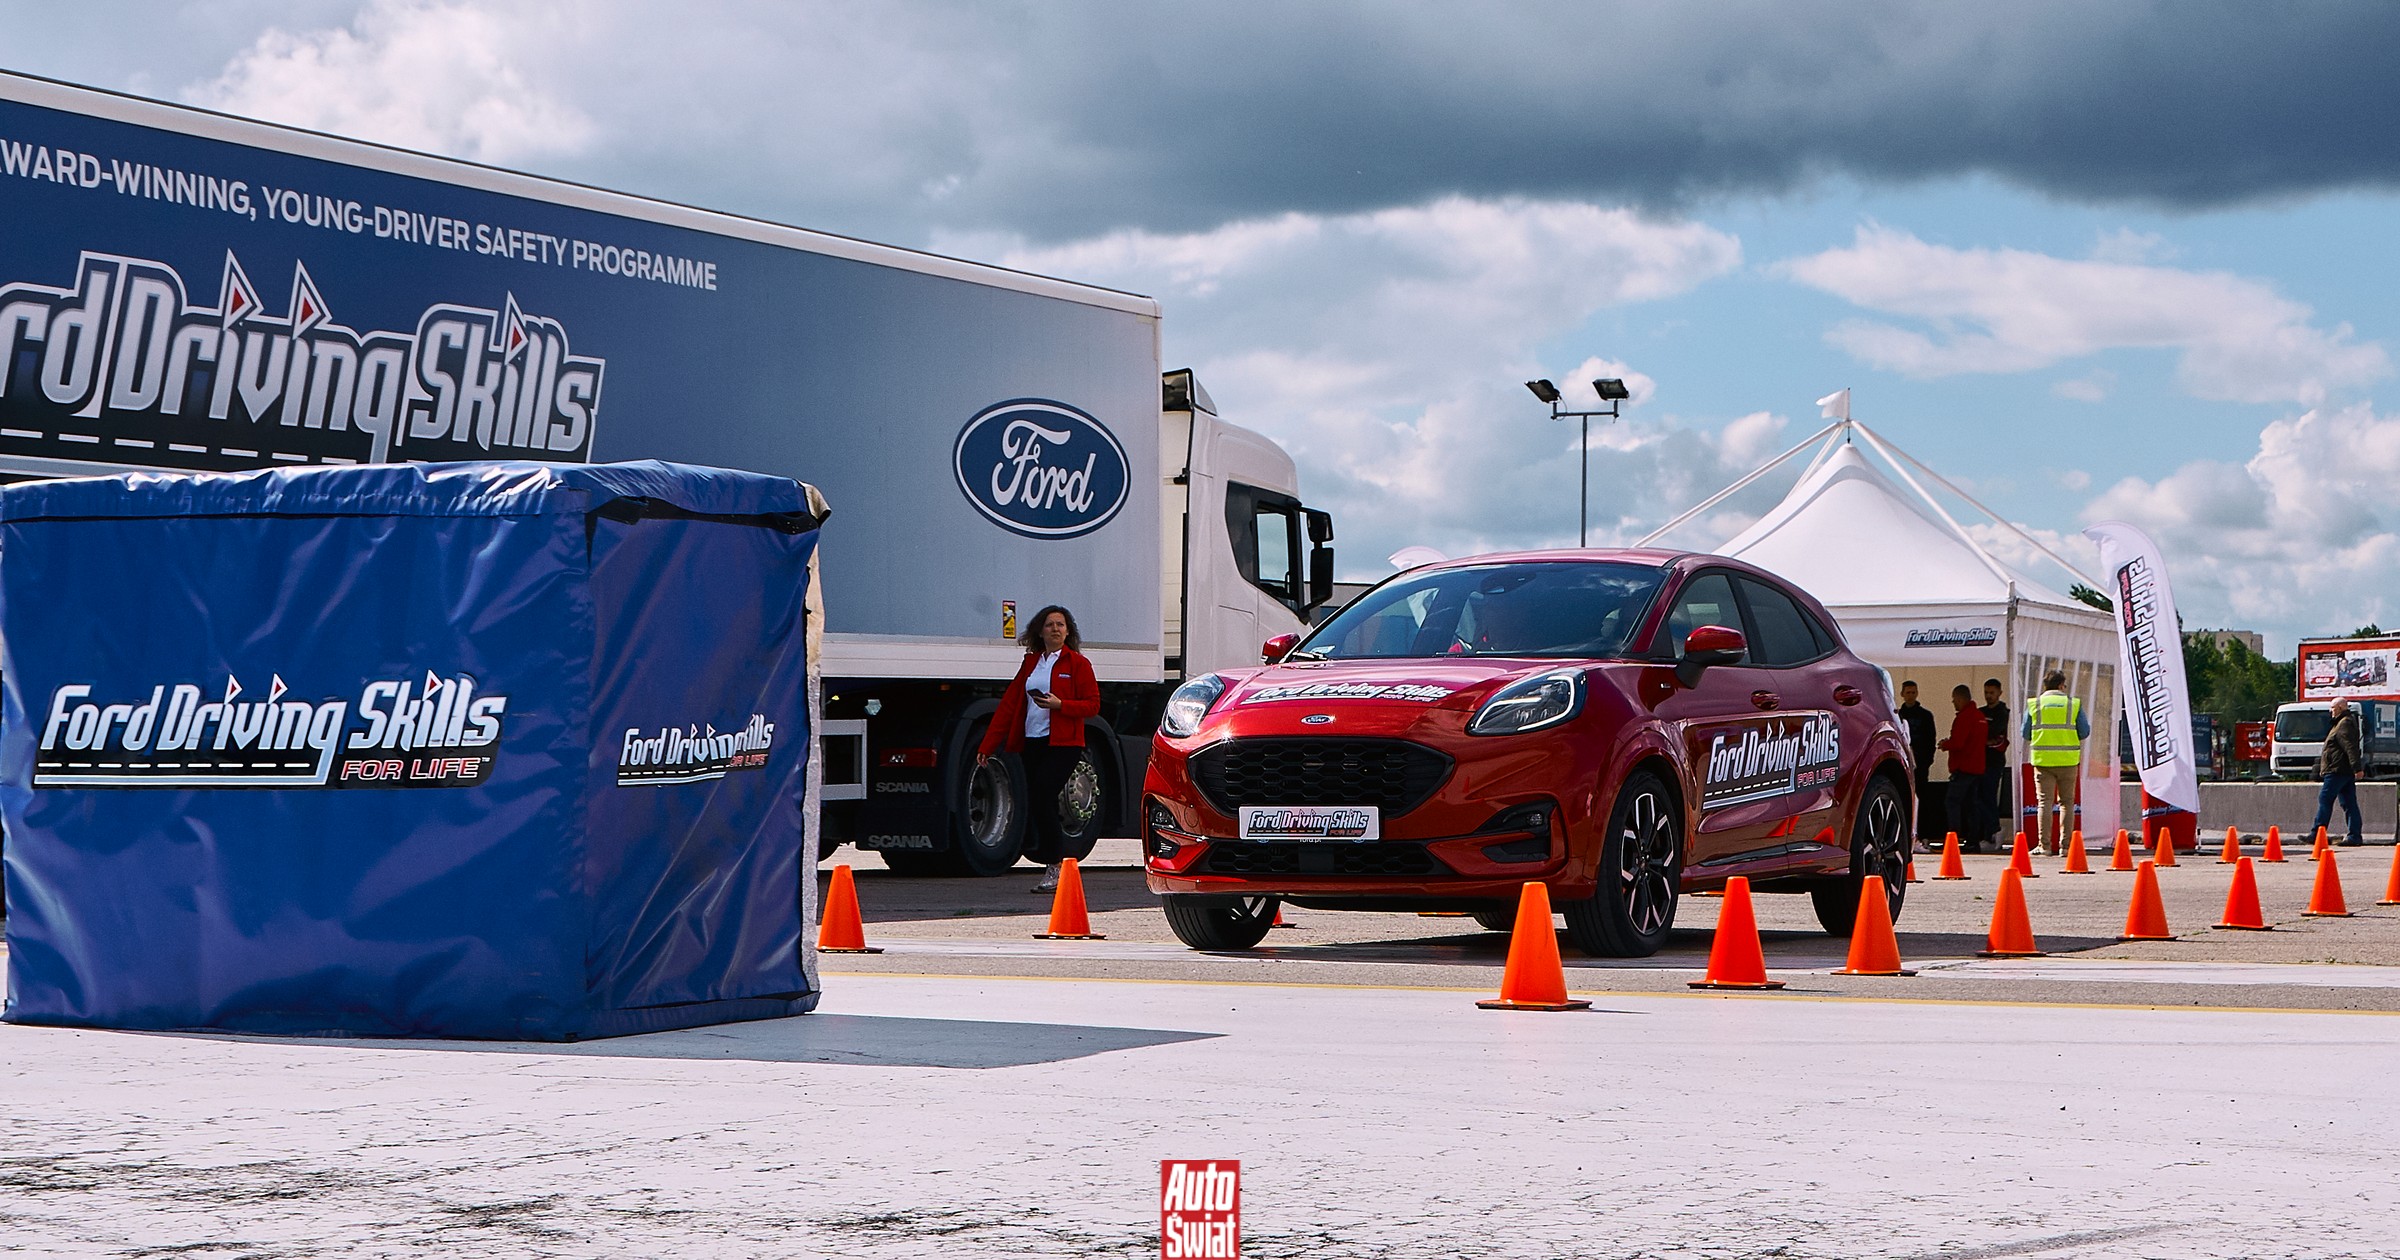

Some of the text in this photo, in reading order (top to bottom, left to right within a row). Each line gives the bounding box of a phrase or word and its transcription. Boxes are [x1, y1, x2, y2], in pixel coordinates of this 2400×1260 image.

[0, 139, 717, 291] WARD-WINNING, YOUNG-DRIVER SAFETY PROGRAMME
[108, 270, 404, 464] Driving
[409, 312, 595, 451] Skills
[992, 419, 1097, 513] Ford
[1907, 627, 1997, 645] Ford Driving Skills
[39, 669, 507, 785] Ford Driving Skills
[620, 728, 667, 765] Ford
[1706, 713, 1839, 792] Ford Driving Skills
[340, 760, 404, 780] FOR
[1797, 772, 1814, 788] FOR
[875, 782, 930, 793] SCANIA
[1249, 809, 1369, 836] Ford Driving Skills
[867, 835, 933, 849] SCANIA
